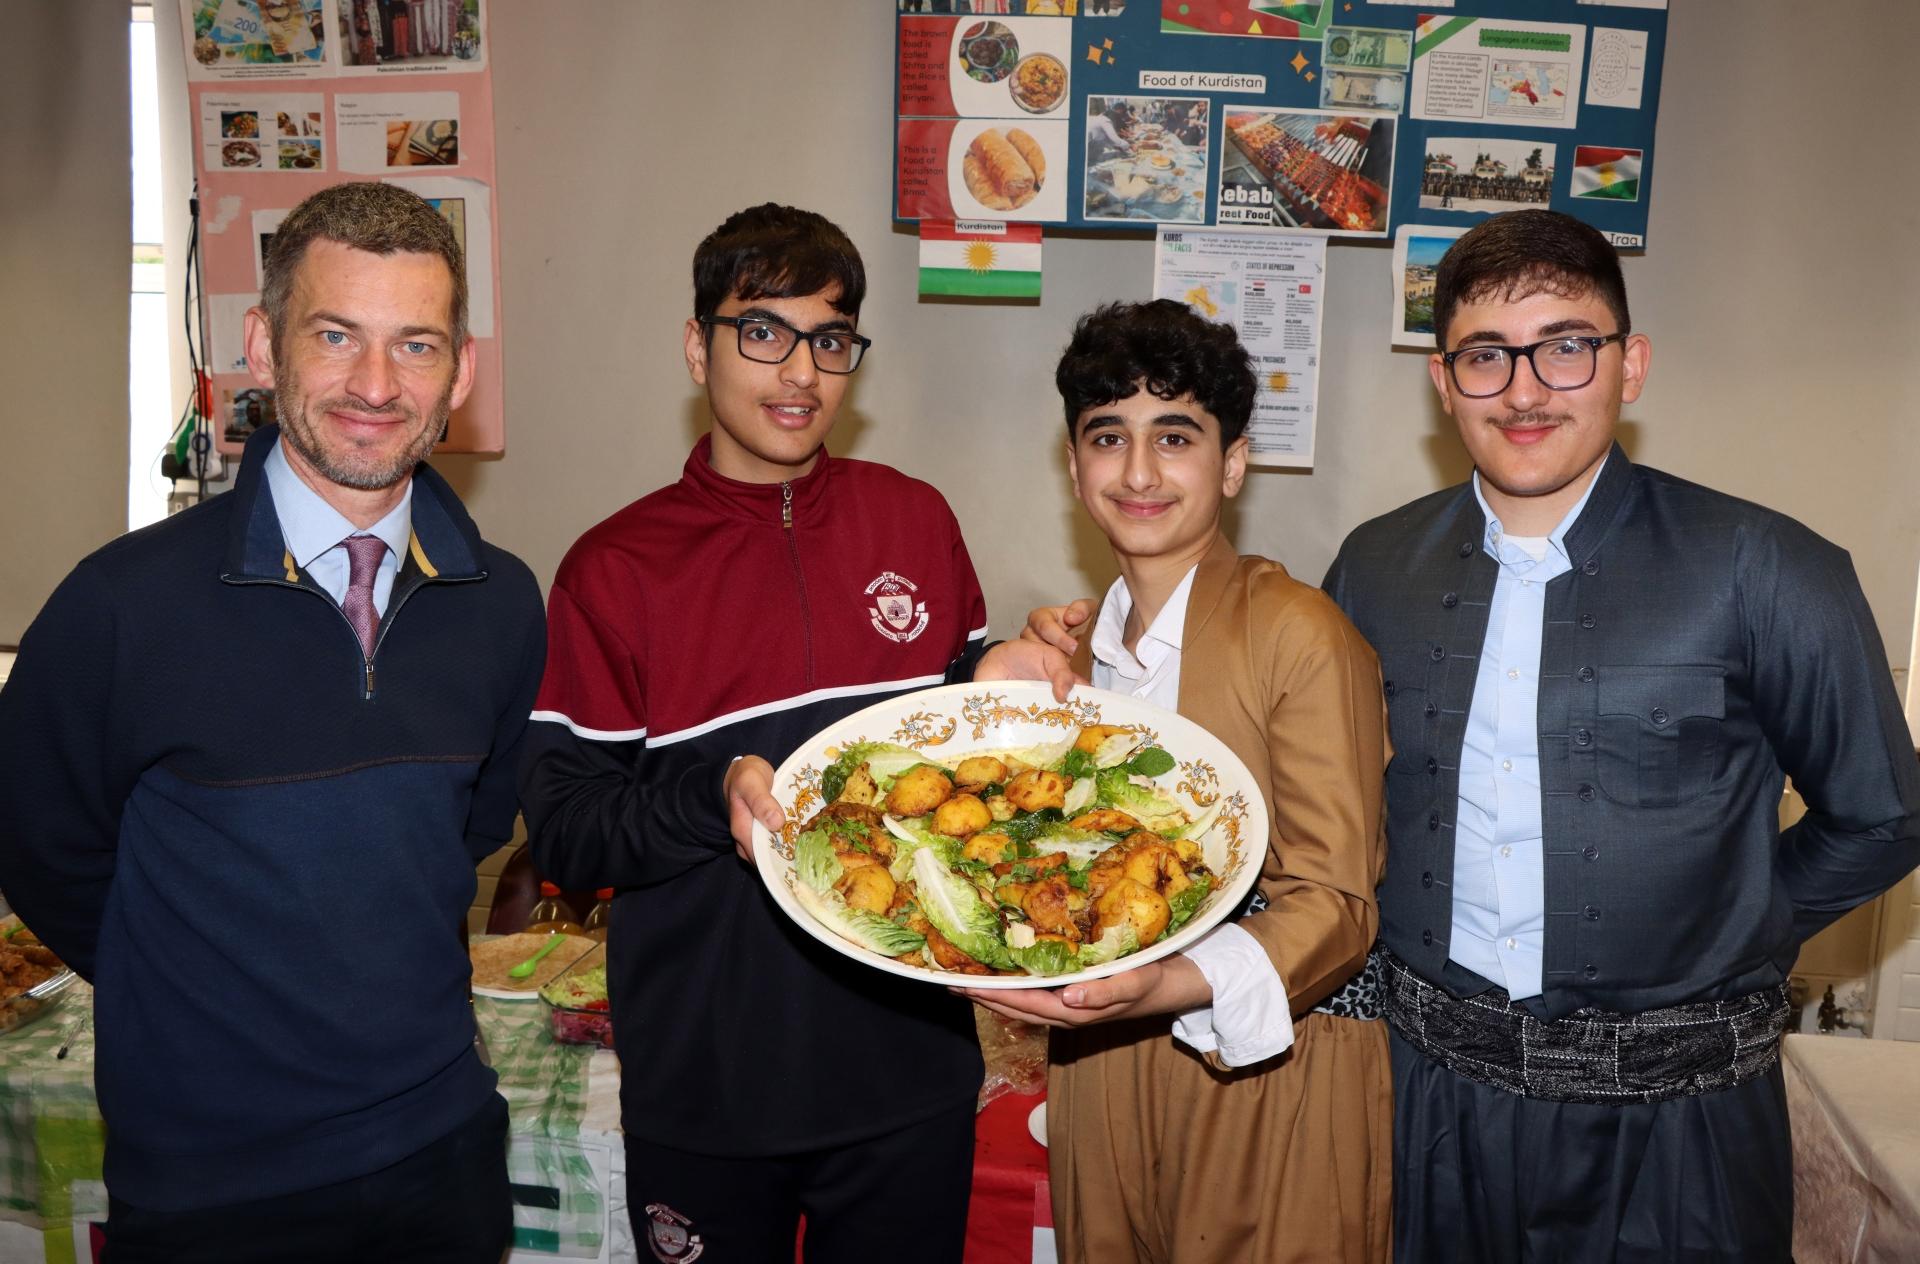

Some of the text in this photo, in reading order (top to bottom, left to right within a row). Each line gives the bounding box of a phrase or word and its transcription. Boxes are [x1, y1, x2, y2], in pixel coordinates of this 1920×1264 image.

[234, 17, 258, 34] 200
[1482, 34, 1519, 45] Languages
[1531, 37, 1565, 45] Kurdistan
[904, 40, 922, 48] food
[903, 50, 928, 58] called
[928, 62, 945, 70] and
[1143, 75, 1263, 88] Food of Kurdistan
[903, 83, 928, 91] called
[904, 145, 920, 153] This
[922, 145, 928, 153] is
[904, 167, 944, 175] Kurdistan
[1220, 210, 1271, 220] reet Food
[1610, 233, 1638, 246] Iraq
